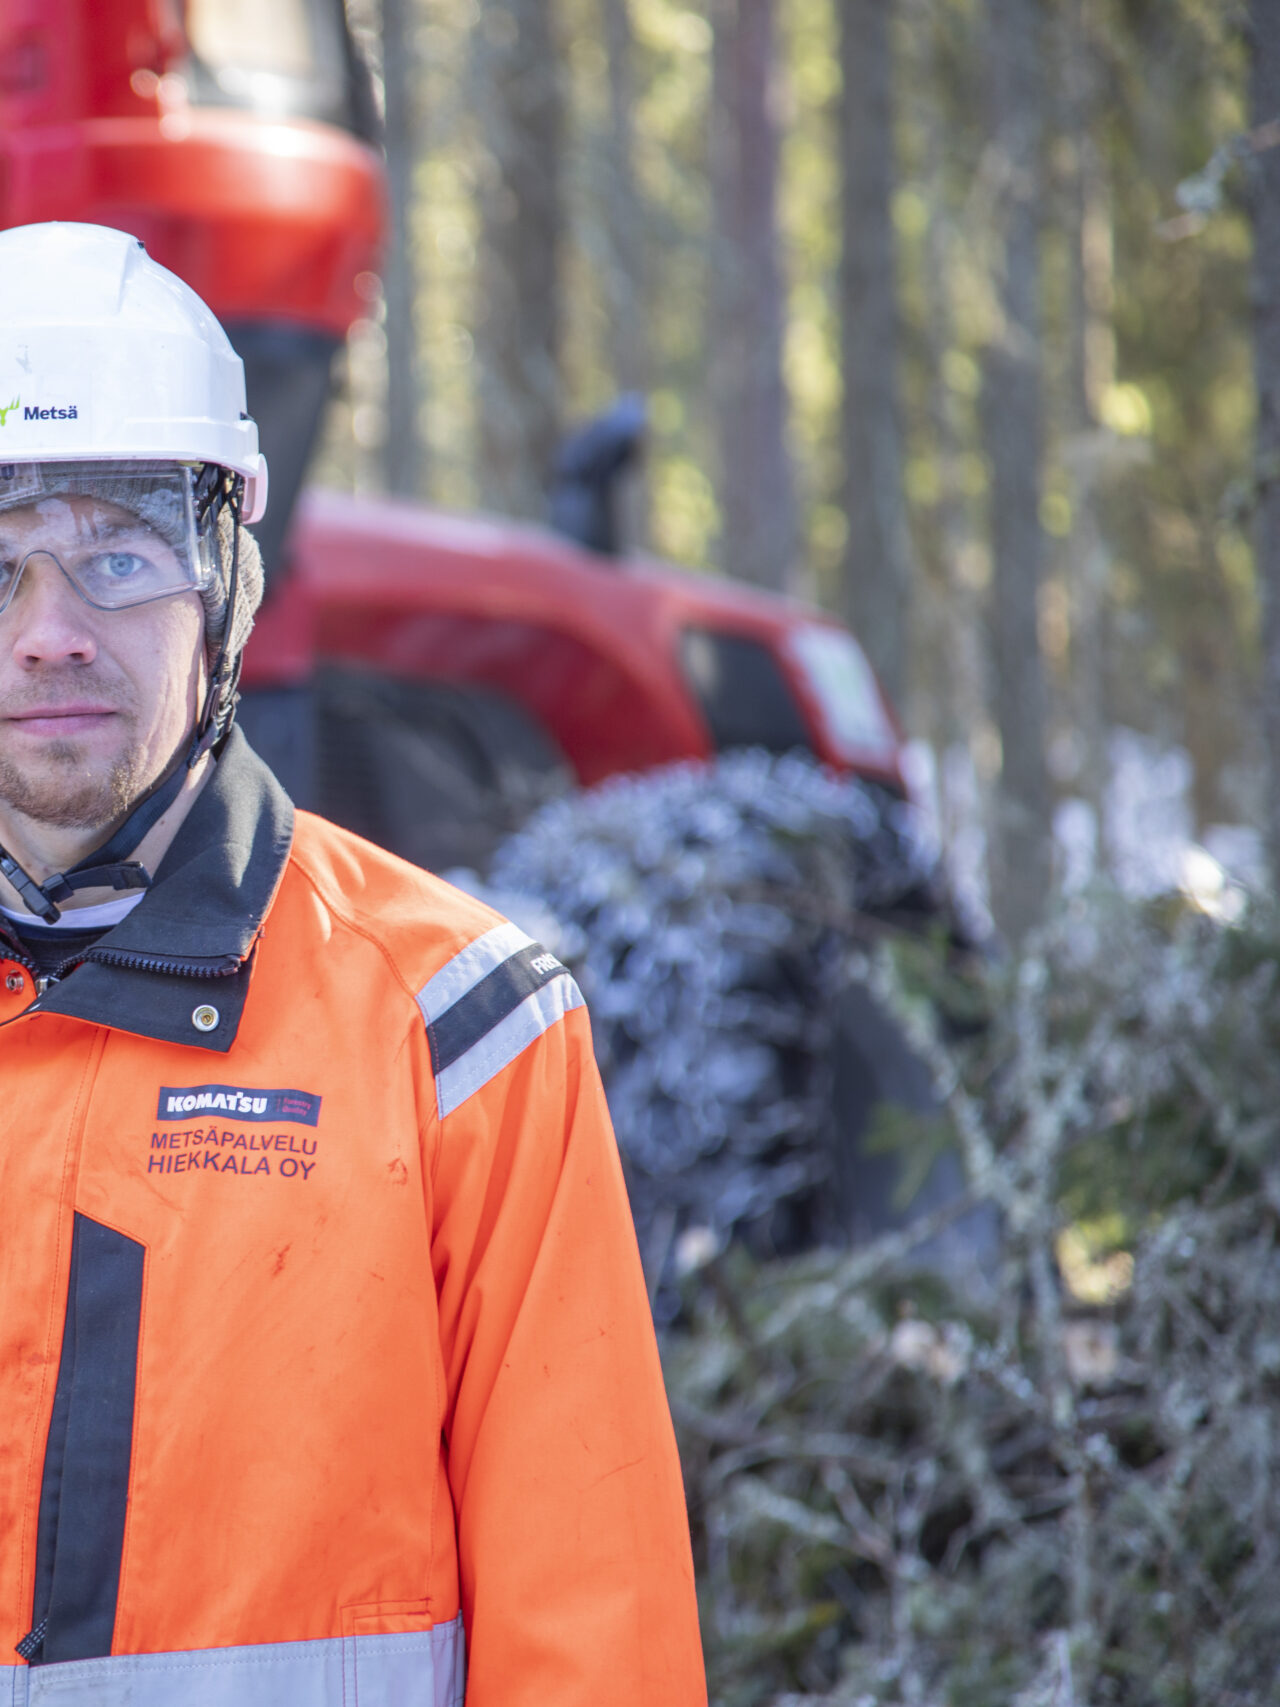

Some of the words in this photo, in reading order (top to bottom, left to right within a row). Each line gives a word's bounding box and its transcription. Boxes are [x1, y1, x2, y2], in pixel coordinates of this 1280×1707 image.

[24, 405, 78, 420] Metsä
[166, 1091, 268, 1114] KOMATSU
[150, 1125, 318, 1155] METSÄPALVELU
[147, 1150, 271, 1176] HIEKKALA
[279, 1157, 316, 1180] OY
